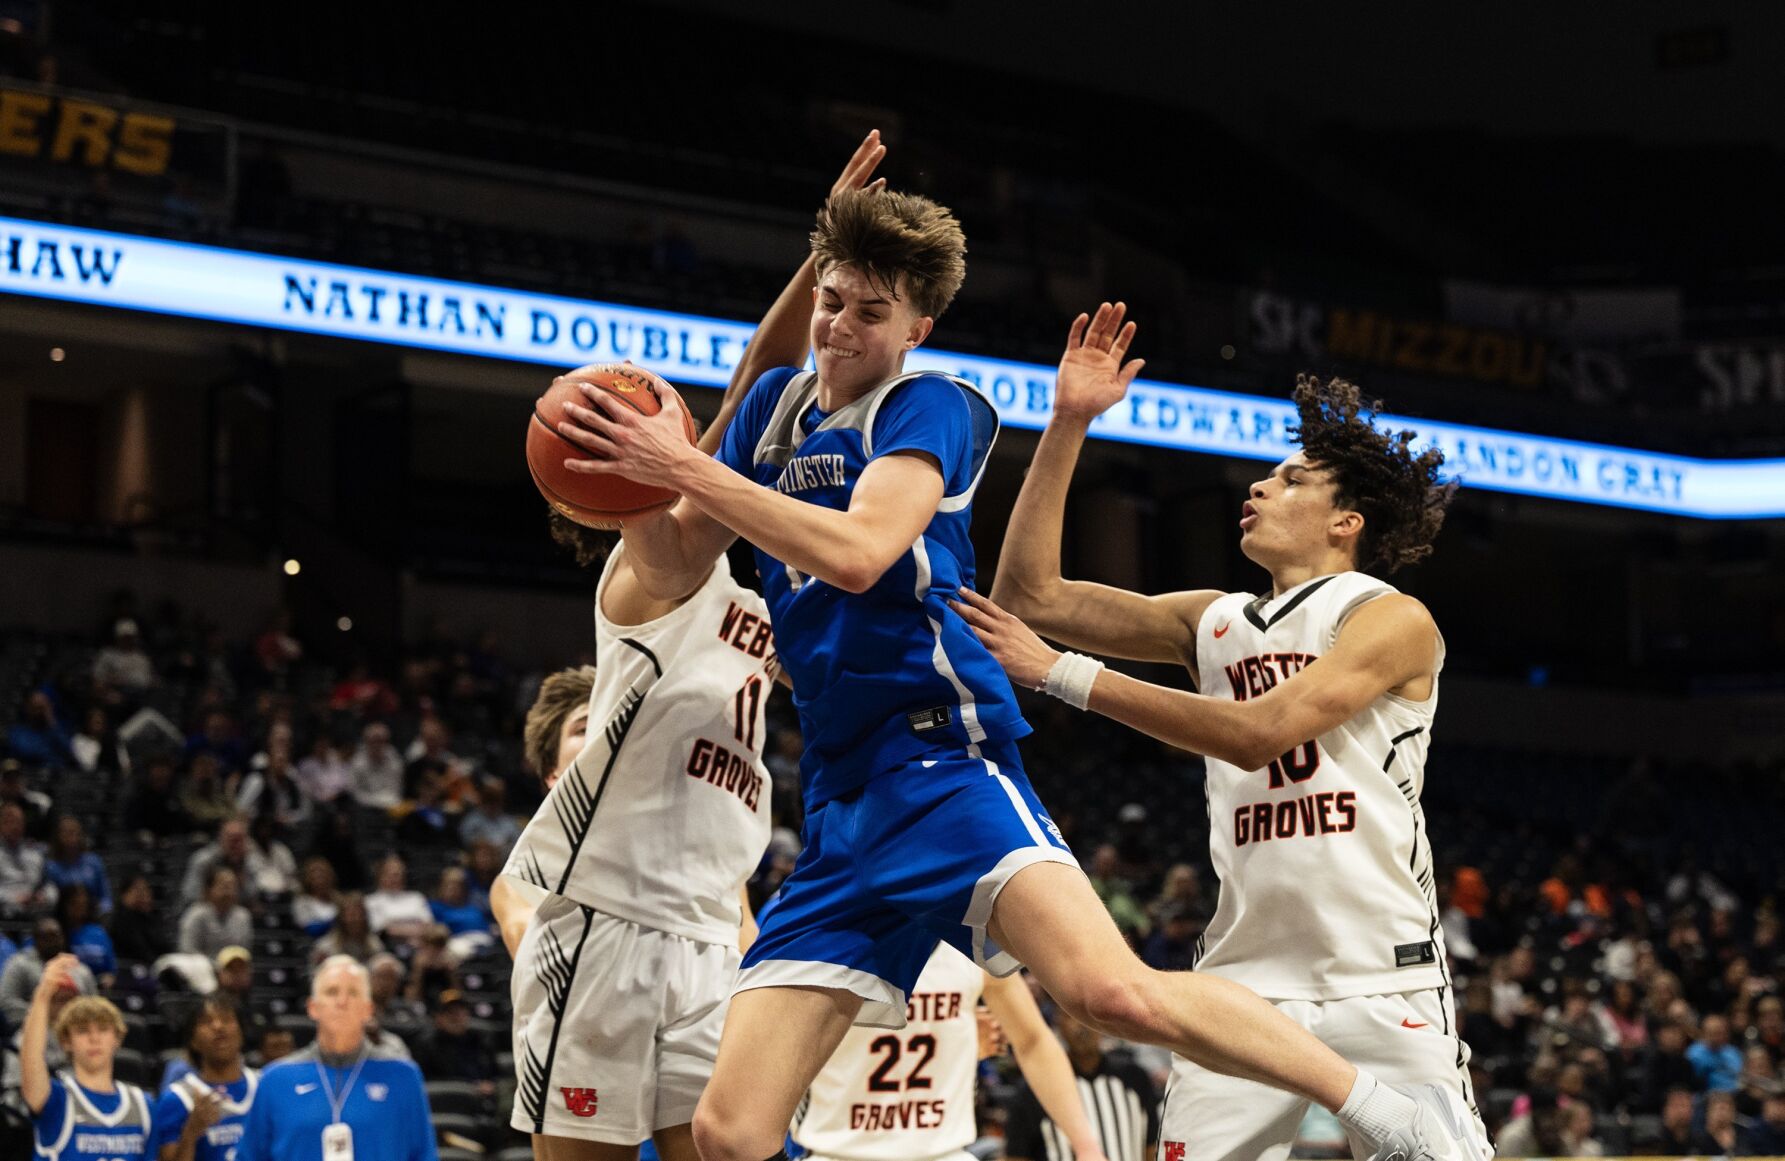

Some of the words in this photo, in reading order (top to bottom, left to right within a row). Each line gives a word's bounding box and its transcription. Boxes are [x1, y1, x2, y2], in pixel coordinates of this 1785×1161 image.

[0, 89, 176, 176] ERS
[284, 273, 506, 340] NATHAN
[530, 309, 749, 370] DOUBLE
[1328, 309, 1546, 389] MIZZOU
[686, 738, 763, 813] GROVES
[1233, 791, 1357, 848] GROVES
[867, 1033, 937, 1093] 22
[850, 1099, 946, 1131] GROVES
